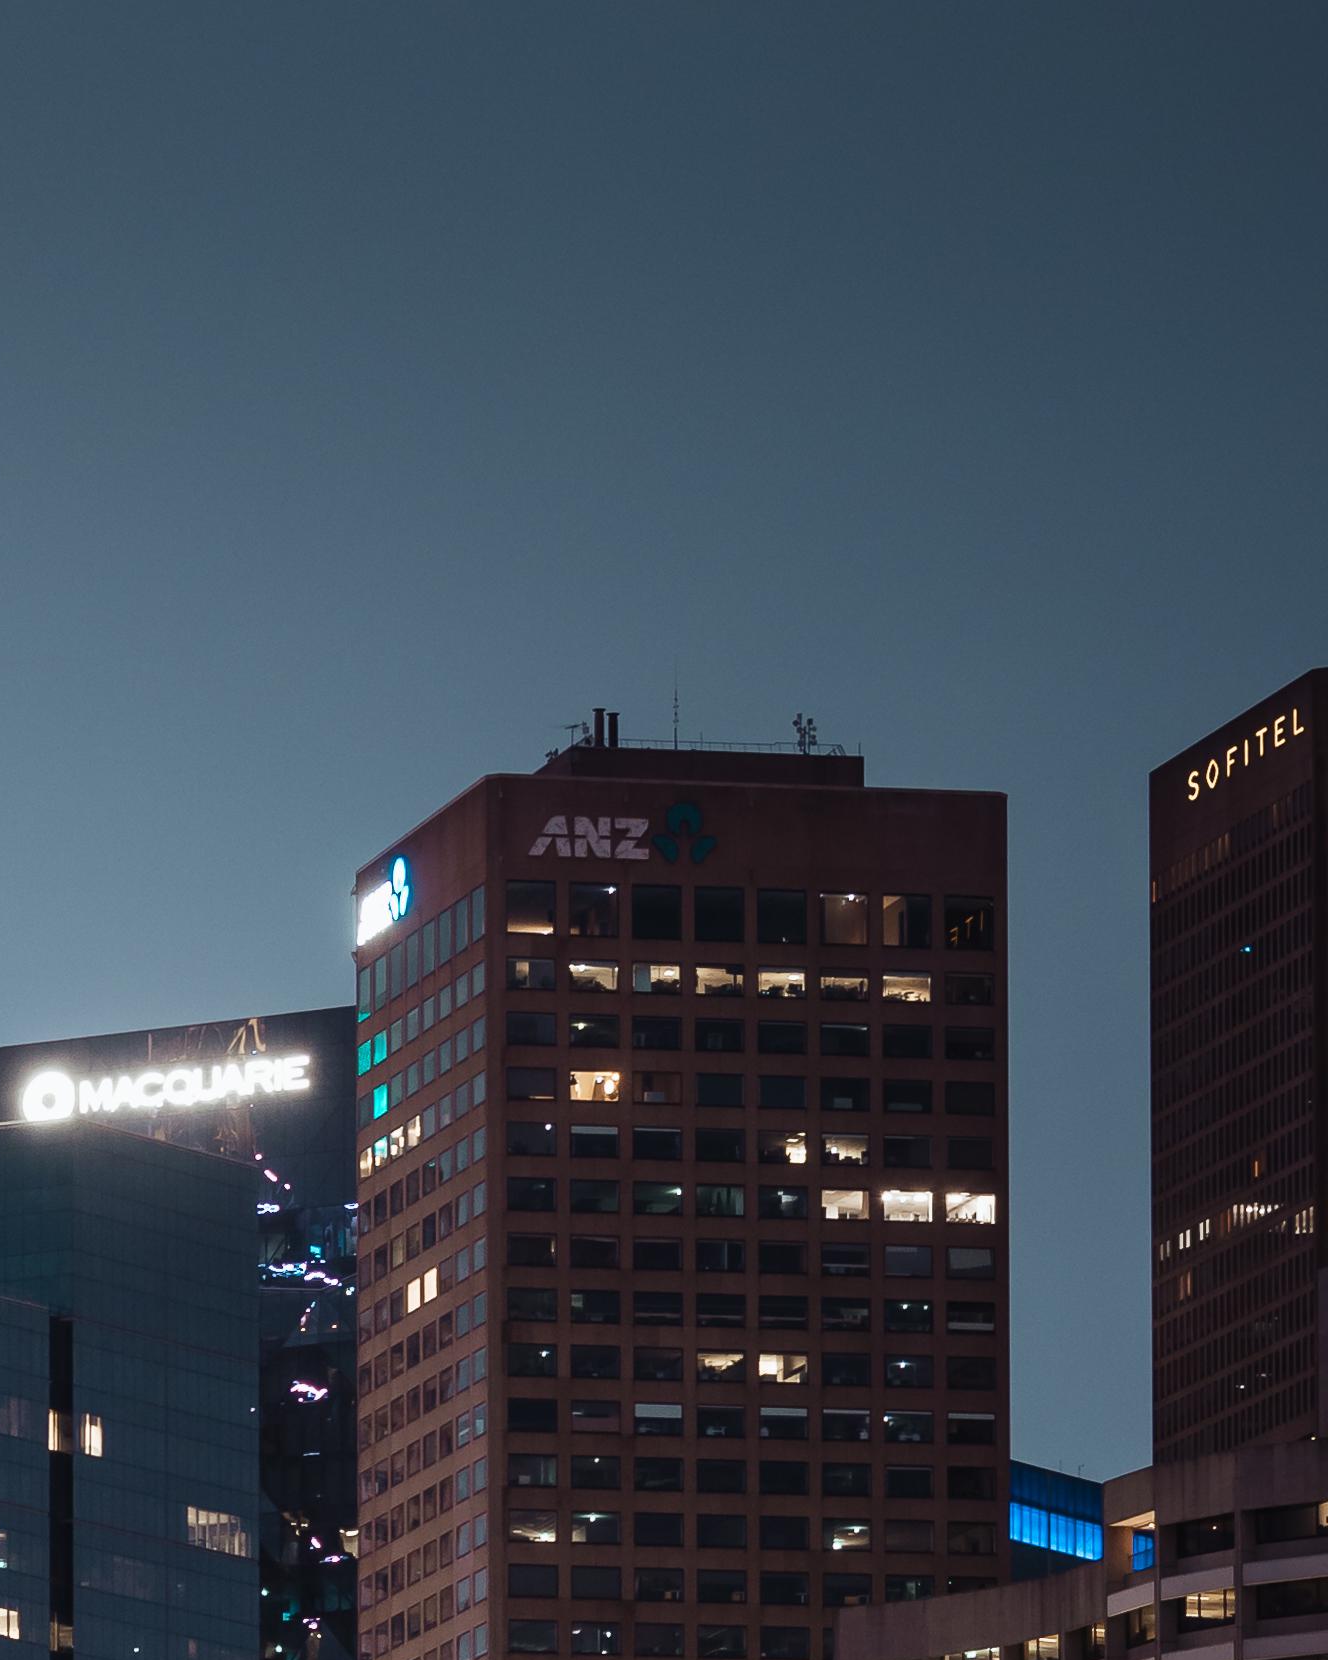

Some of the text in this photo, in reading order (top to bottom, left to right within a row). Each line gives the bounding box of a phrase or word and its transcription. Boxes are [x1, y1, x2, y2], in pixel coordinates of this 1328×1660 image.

[1187, 708, 1305, 801] SOFITEL
[528, 815, 650, 860] ANZ
[78, 1055, 311, 1114] MACQUARIE
